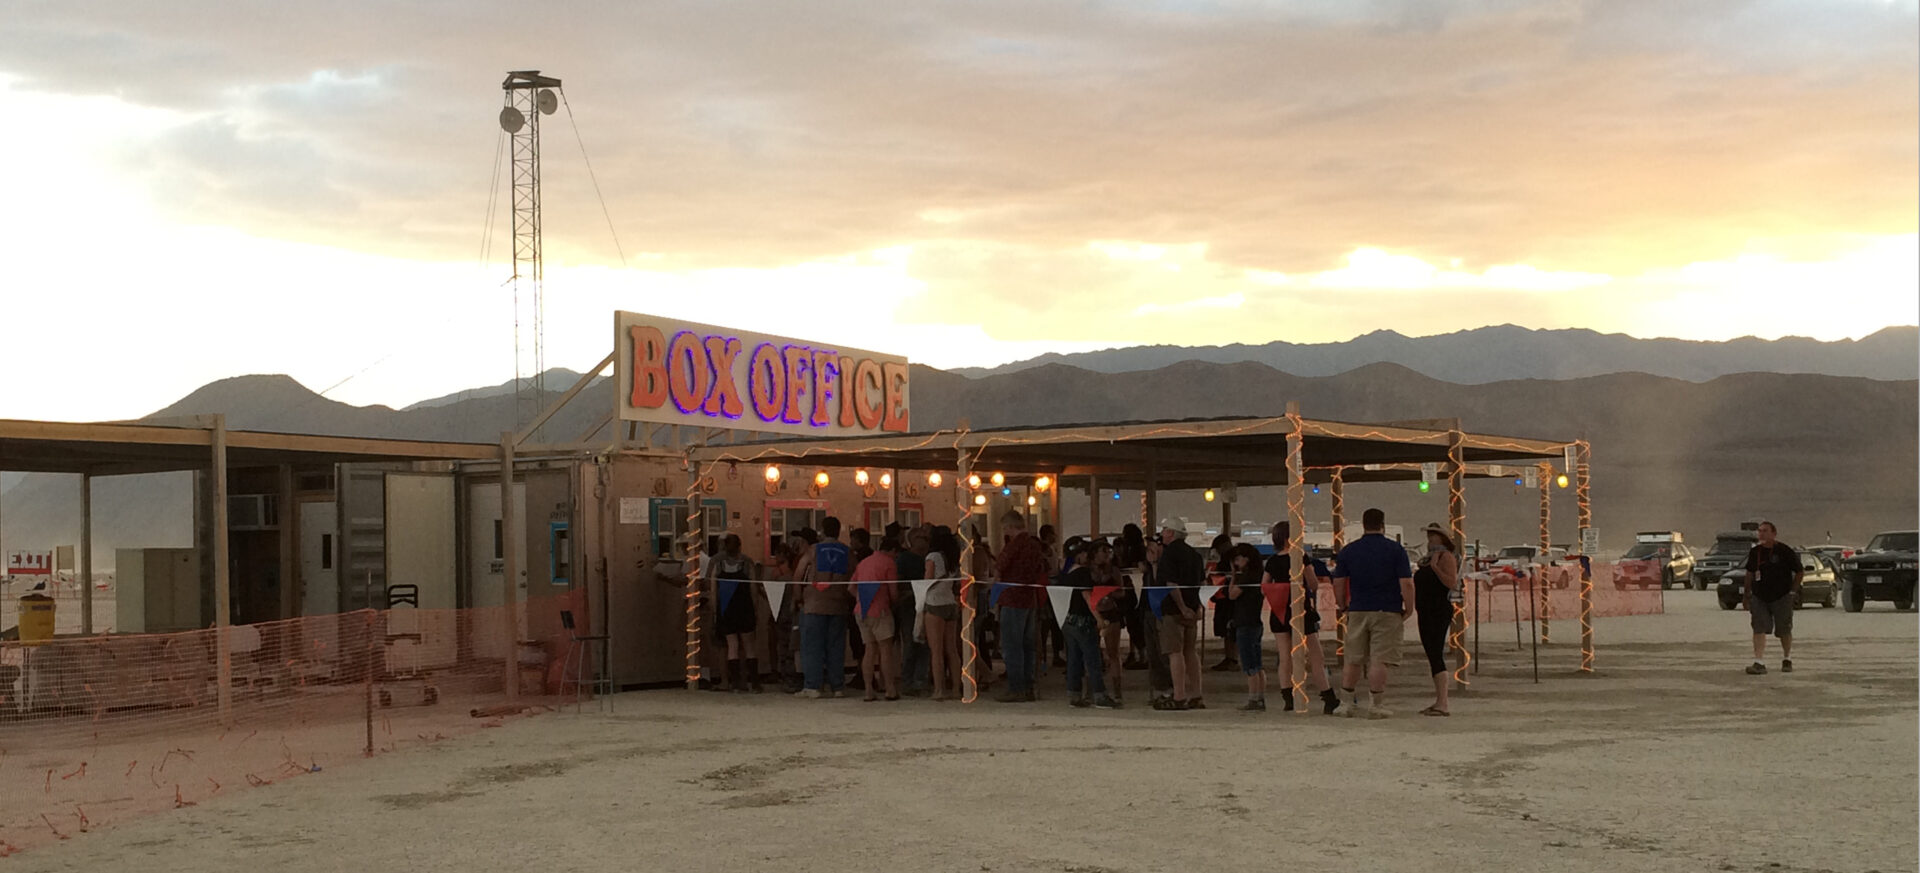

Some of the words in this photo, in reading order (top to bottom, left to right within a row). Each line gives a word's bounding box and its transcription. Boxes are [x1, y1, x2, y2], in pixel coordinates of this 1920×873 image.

[630, 325, 744, 419] BOX
[749, 342, 908, 432] OFFICE
[705, 476, 714, 492] 2
[8, 551, 51, 569] EXIT
